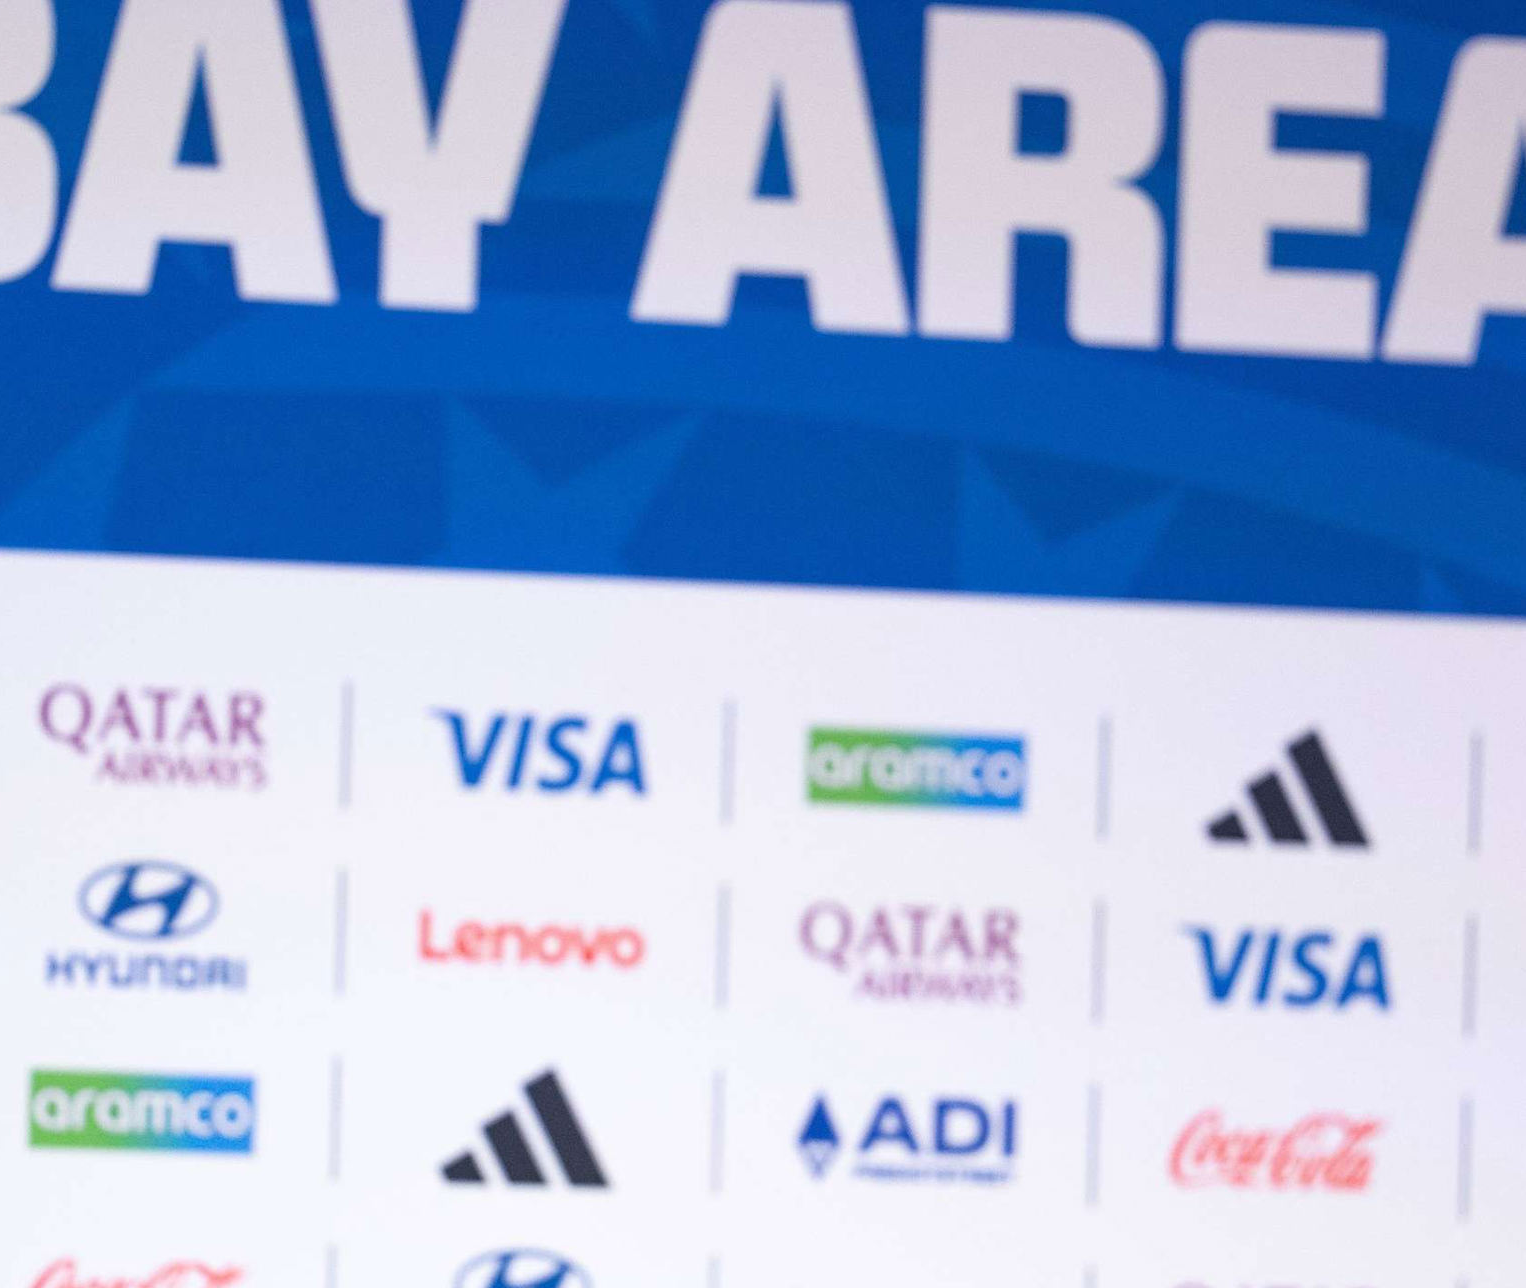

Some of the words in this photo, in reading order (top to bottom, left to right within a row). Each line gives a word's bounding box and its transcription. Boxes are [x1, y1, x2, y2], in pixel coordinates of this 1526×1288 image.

[37, 684, 265, 752] QATAR
[83, 752, 267, 790] AIRWAYS
[435, 711, 647, 795] VISA
[810, 735, 1024, 800] aramco
[417, 909, 647, 971] Lenovo
[798, 903, 1020, 975] QATAR
[1185, 928, 1391, 1010] VISA
[45, 952, 247, 991] HYUNDAI
[30, 1083, 253, 1138] aramco
[859, 1096, 1017, 1158] ADI
